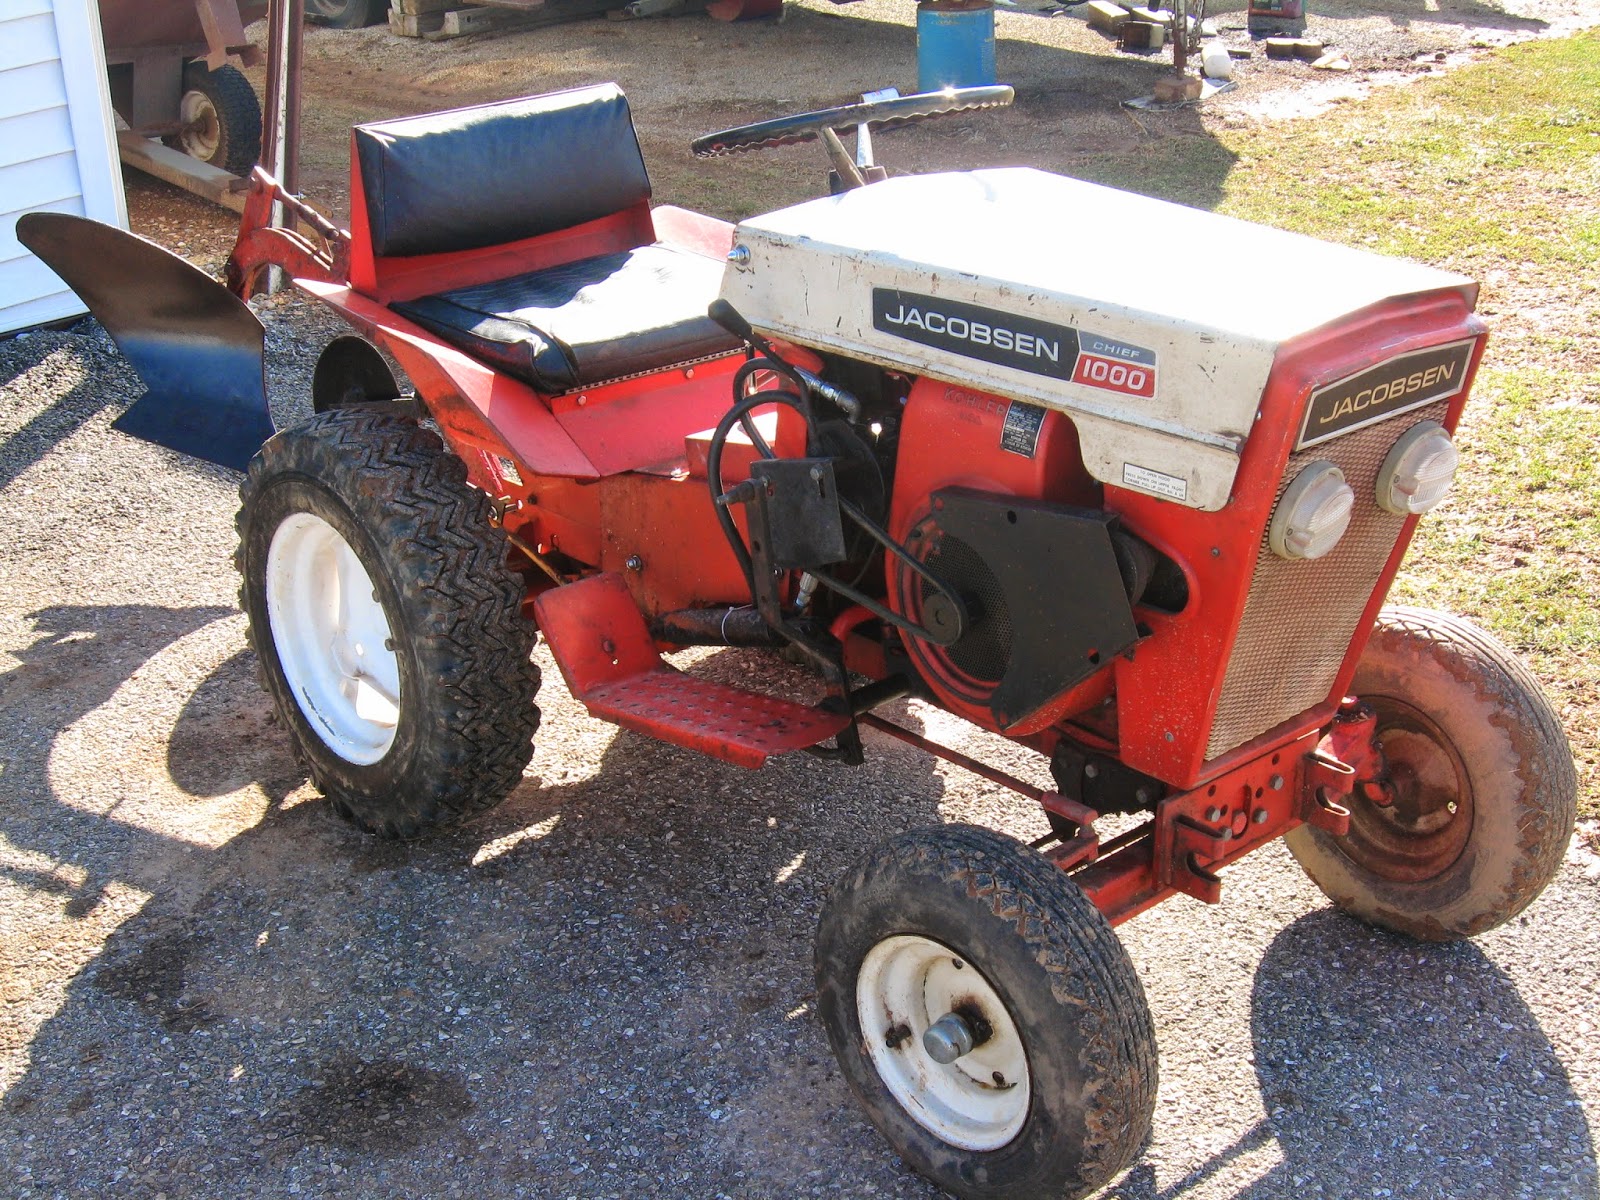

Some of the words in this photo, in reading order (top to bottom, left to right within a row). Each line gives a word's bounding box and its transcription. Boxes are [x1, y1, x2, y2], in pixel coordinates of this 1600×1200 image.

[885, 305, 1059, 362] JACOBSEN
[1093, 341, 1140, 358] CHIEF
[1082, 359, 1146, 390] 1000
[944, 386, 1007, 417] KOHLER
[1320, 361, 1456, 424] JACOBSEN
